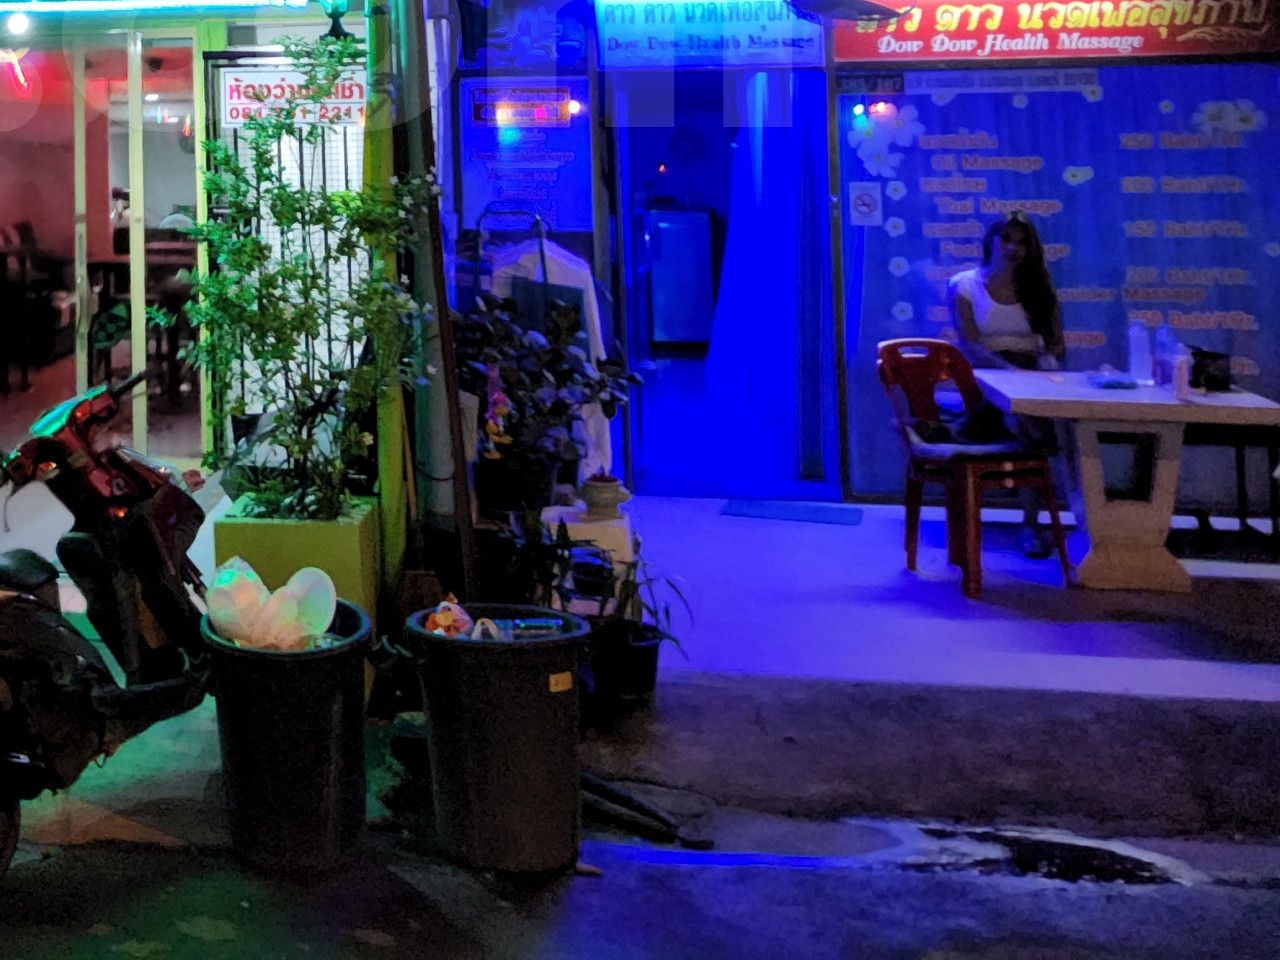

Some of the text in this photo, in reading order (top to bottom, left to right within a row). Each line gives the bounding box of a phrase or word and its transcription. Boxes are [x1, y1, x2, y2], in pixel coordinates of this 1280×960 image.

[934, 0, 1005, 31] ดาว
[877, 32, 1144, 57] Dow Dow Health Massage
[962, 154, 1045, 174] Massage
[980, 197, 1064, 217] Massage
